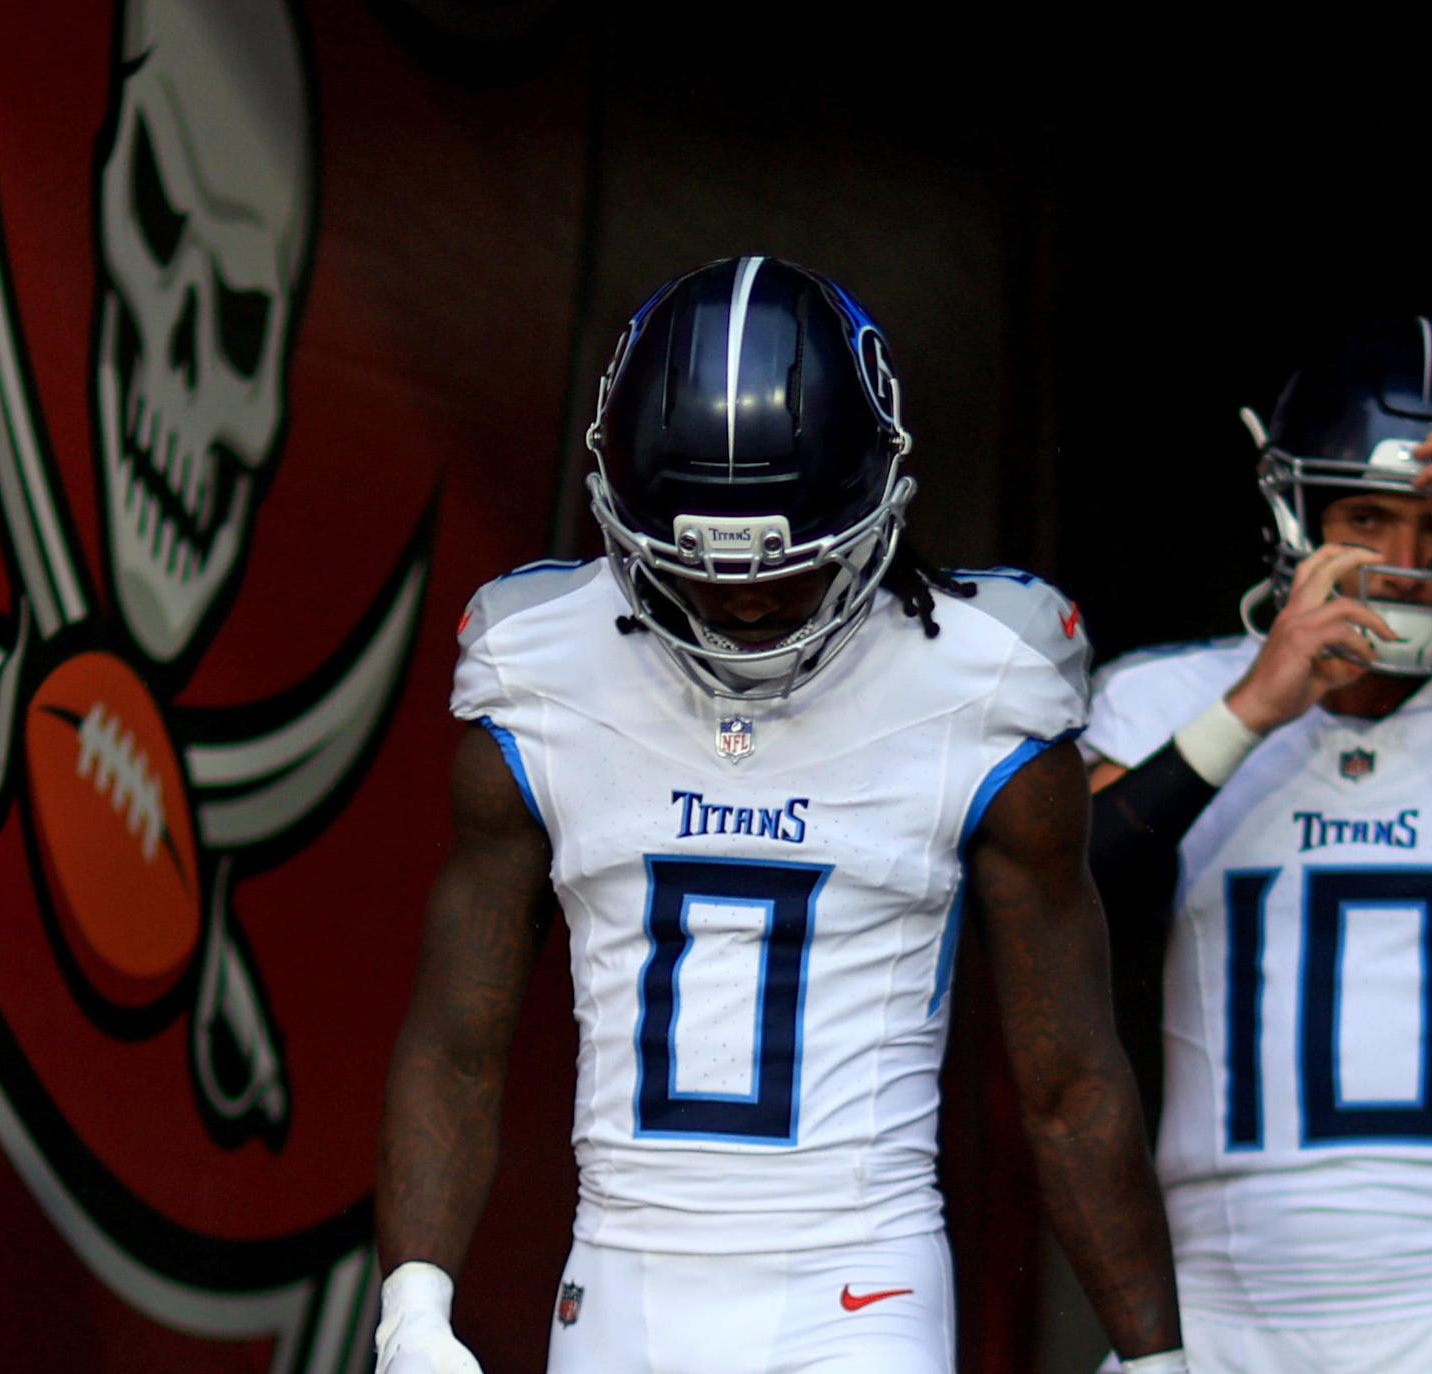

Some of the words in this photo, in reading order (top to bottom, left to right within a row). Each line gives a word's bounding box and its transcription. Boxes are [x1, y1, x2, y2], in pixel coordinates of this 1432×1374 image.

[708, 527, 751, 542] TITANS
[720, 733, 750, 750] NFL
[671, 790, 810, 843] TITANS
[1292, 809, 1419, 853] TITANS
[633, 854, 836, 1146] 0
